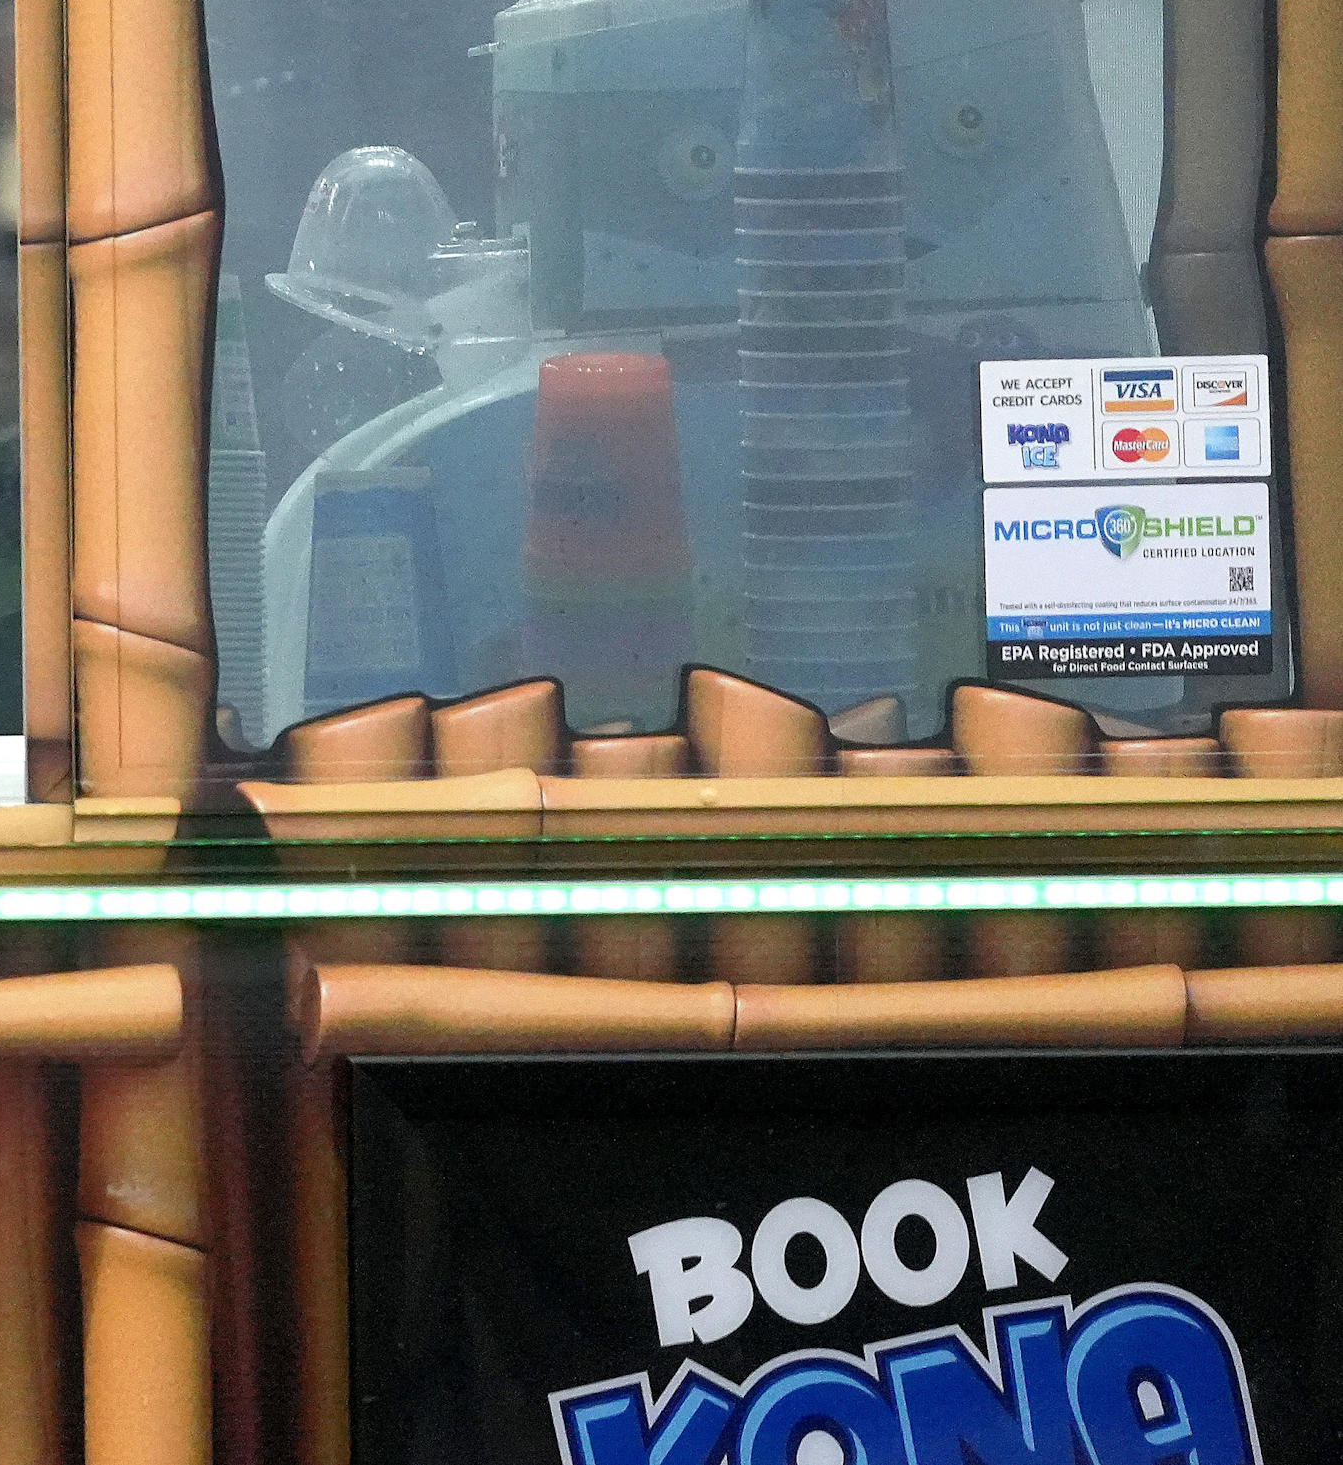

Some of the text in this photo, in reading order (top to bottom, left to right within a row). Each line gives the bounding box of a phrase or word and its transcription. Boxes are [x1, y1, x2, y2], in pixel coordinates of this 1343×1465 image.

[1001, 378, 1073, 390] WE ACCEPT
[1116, 382, 1162, 399] VISA
[1196, 380, 1243, 391] DISCOVER
[992, 394, 1083, 408] CREDIT CARDS
[1007, 423, 1070, 445] KONA
[1113, 438, 1170, 452] MasterCard
[1021, 444, 1059, 469] ICE
[994, 520, 1097, 542] MICRO
[1144, 515, 1256, 537] SHIELD
[1142, 546, 1256, 559] CERTIFIED LOCATION
[999, 622, 1020, 633] This
[1049, 621, 1069, 632] unit
[1072, 621, 1081, 632] is
[1083, 621, 1100, 632] not
[1183, 618, 1217, 629] MICRO
[1220, 616, 1261, 628] CLEAN!
[1001, 640, 1259, 662] EPA Registered FDA Approved
[1053, 660, 1209, 673] for Direct Food Contact Surfaces
[627, 1166, 1070, 1347] BOOK
